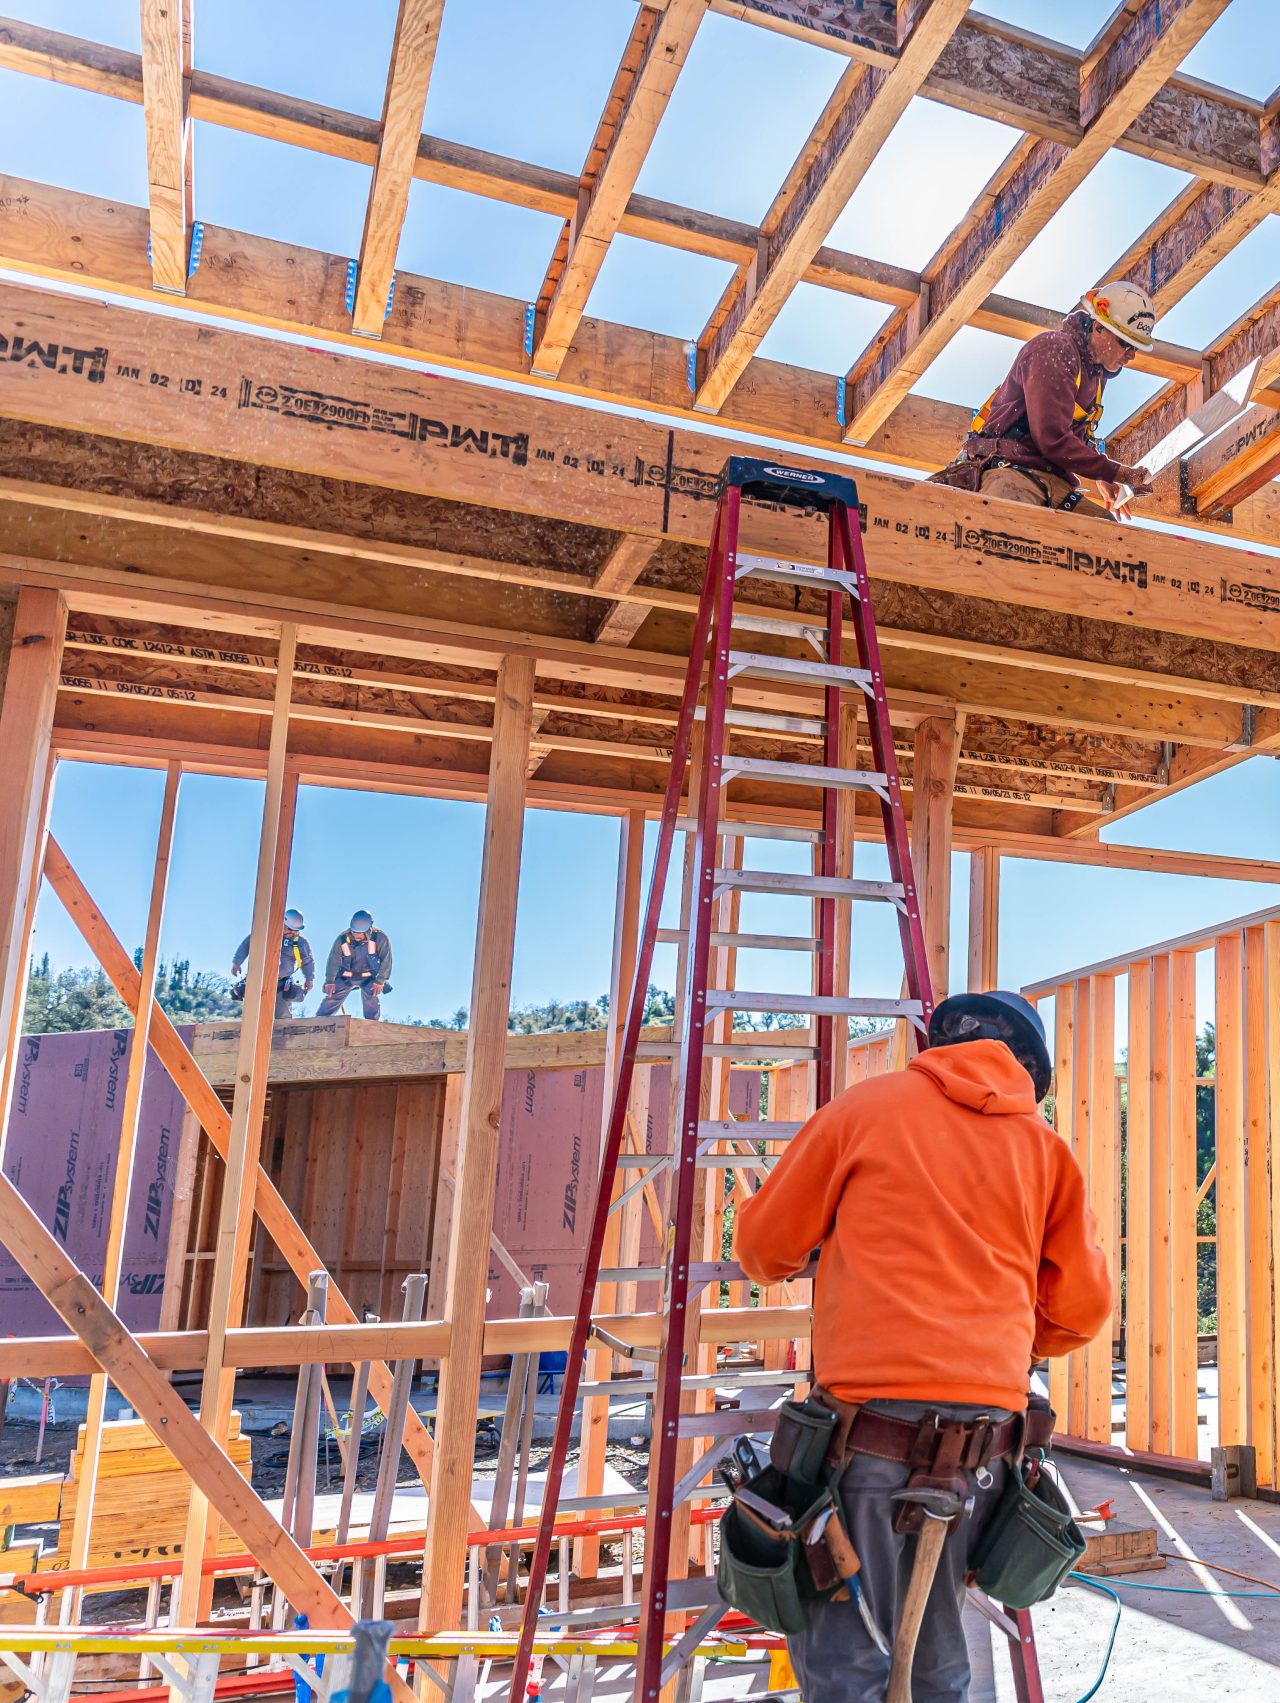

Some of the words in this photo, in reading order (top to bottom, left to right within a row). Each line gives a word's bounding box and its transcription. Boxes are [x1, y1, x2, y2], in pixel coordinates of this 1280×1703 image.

[115, 364, 141, 380] JAN
[149, 372, 170, 388] 02
[210, 384, 228, 399] 24
[419, 417, 529, 467] PWT
[535, 447, 555, 461] JAN
[562, 456, 579, 469] 02
[775, 468, 814, 482] WERNER
[872, 515, 890, 529] JAN
[895, 522, 909, 535] 02
[935, 530, 948, 542] 24
[1074, 550, 1148, 590] PWT
[1151, 572, 1166, 585] JAN
[1170, 578, 1182, 590] 02
[1204, 584, 1215, 596] 24
[64, 630, 108, 648] SR-1305
[190, 645, 216, 660] ASTM
[218, 650, 250, 665] D5055
[323, 665, 353, 679] 05:12
[61, 676, 93, 689] D5055
[116, 682, 164, 698] 09/05/23
[167, 686, 196, 701] 05:12
[981, 787, 1011, 799] 09/05/23
[1013, 791, 1031, 801] 05:12
[562, 1182, 578, 1235] ZIP
